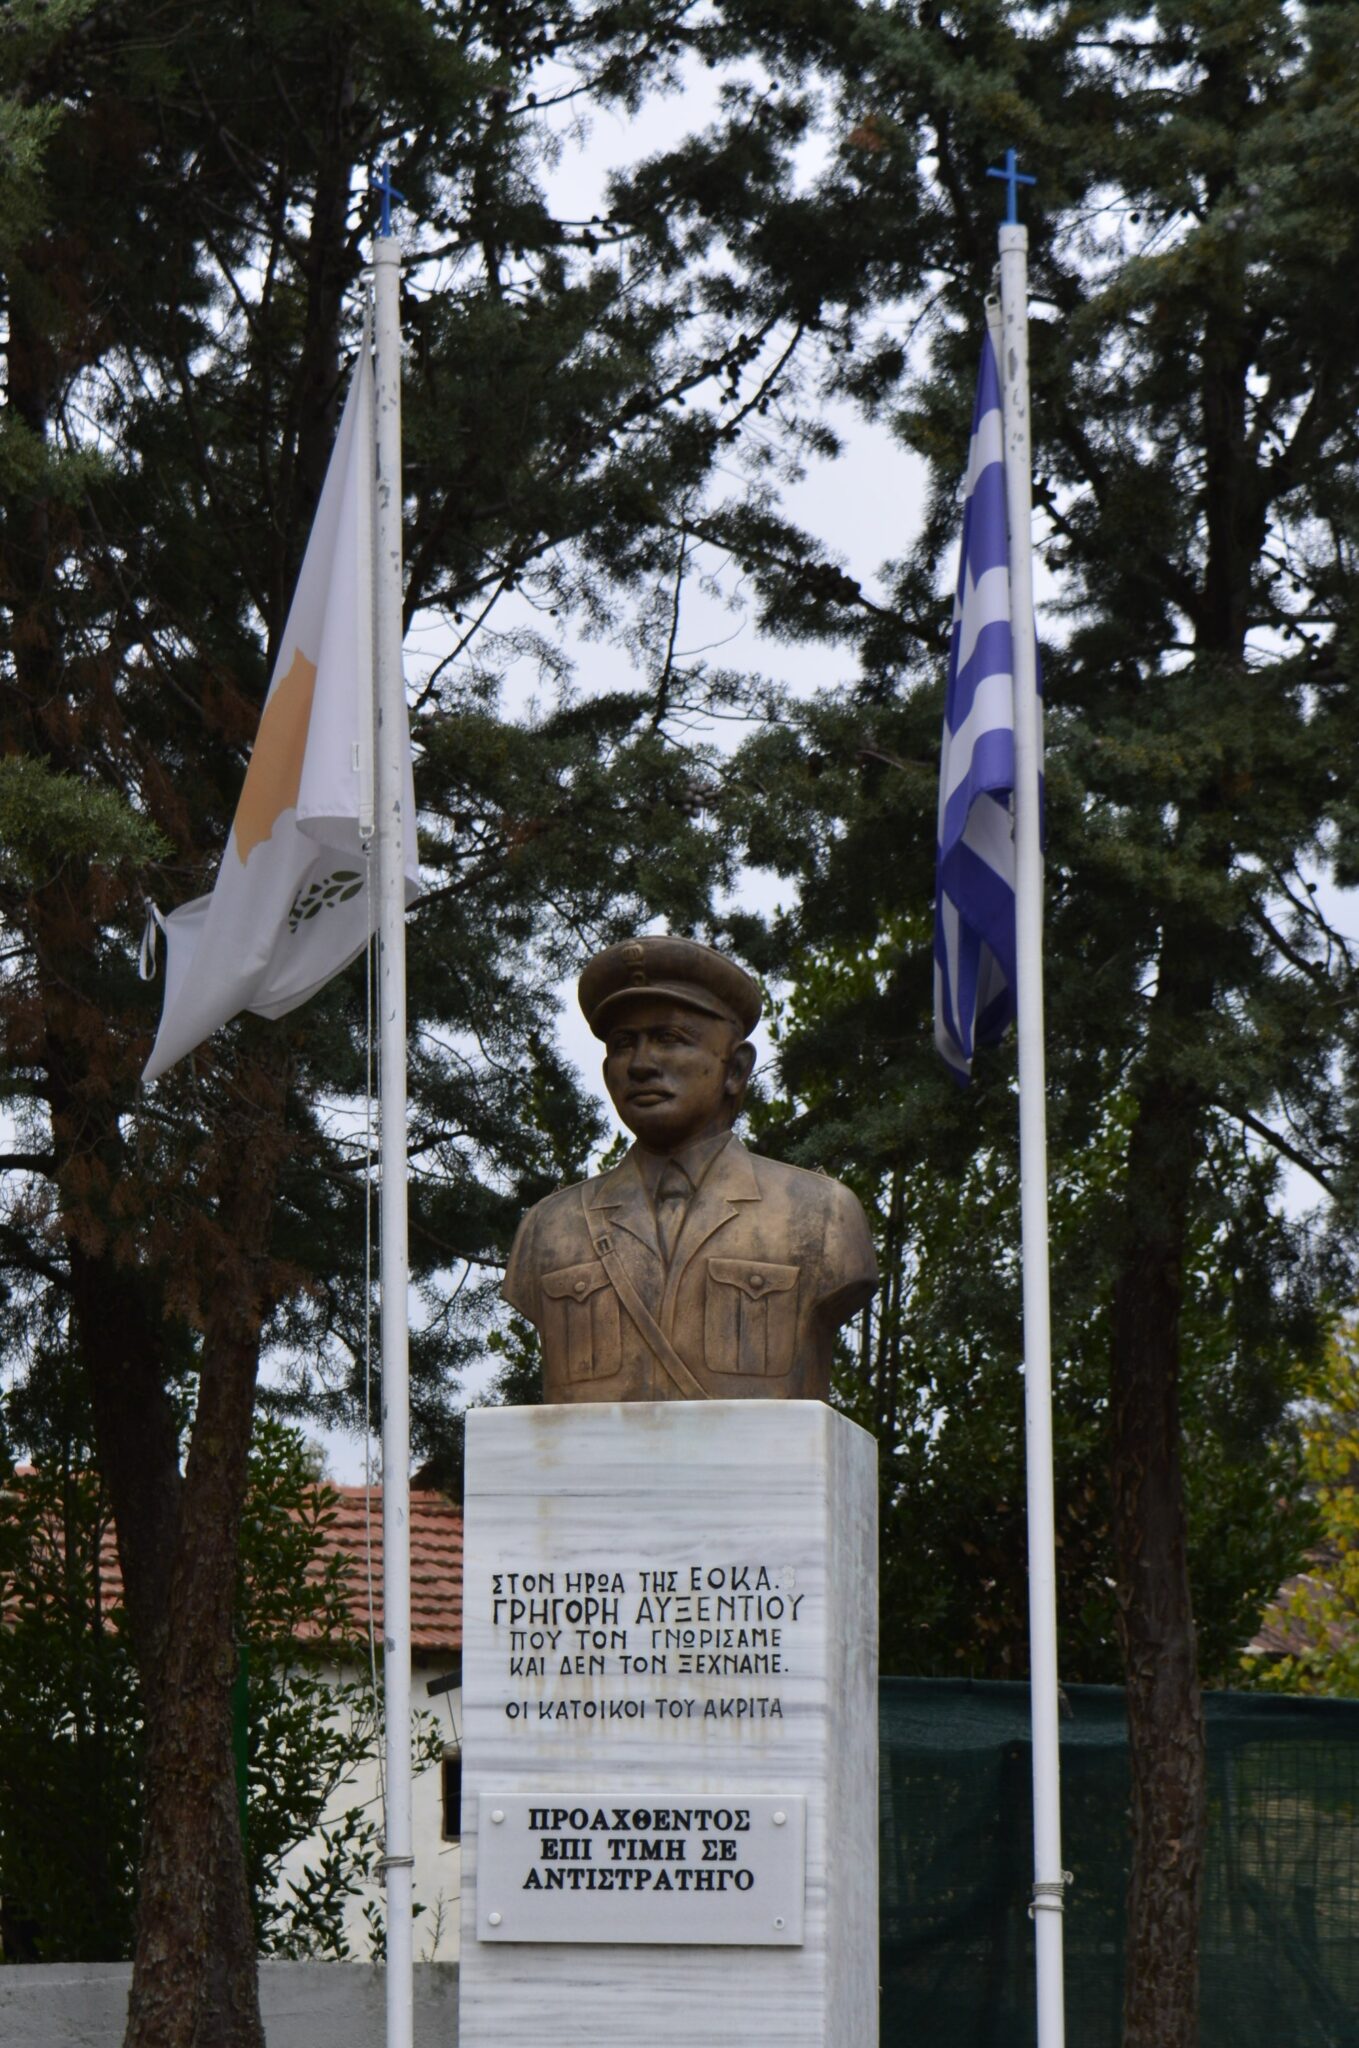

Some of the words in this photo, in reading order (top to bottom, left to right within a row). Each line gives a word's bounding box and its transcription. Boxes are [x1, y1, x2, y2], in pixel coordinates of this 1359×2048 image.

[492, 1573, 554, 1595] ΣΤΟΝ
[566, 1573, 625, 1594] ΗΡΩΑ
[639, 1571, 679, 1593] ΤΗΣ
[492, 1598, 618, 1625] ΓΡΗΓΟΡΗ
[635, 1594, 804, 1625] ΑΥΞΕΝΤΙΟΥ
[510, 1631, 562, 1650] ΠΟΥ
[576, 1630, 627, 1649] ΤΟΝ
[652, 1628, 782, 1649] ΓΝΩΡΙΣΑΜΕ
[510, 1656, 545, 1676] ΚΑΙ
[560, 1656, 605, 1675] ΔΕΝ
[619, 1655, 666, 1674] ΤΟΝ
[505, 1701, 528, 1719] ΟΙ
[539, 1700, 645, 1719] ΚΑΤΟΙΚΟΙ
[655, 1699, 696, 1719] ΤΟΥ
[703, 1698, 783, 1719] ΑΚΡΙΤΑ
[528, 1808, 750, 1831] ΠΡΟΑΧΘΕΝΤΟΣ
[540, 1838, 592, 1860] ΕΠΙ
[608, 1839, 686, 1861] ΤΙΜΗ
[701, 1840, 737, 1861] ΣΕ
[522, 1868, 754, 1891] ΑΝΤΙΣΤΡΑΤΗΓΟ
